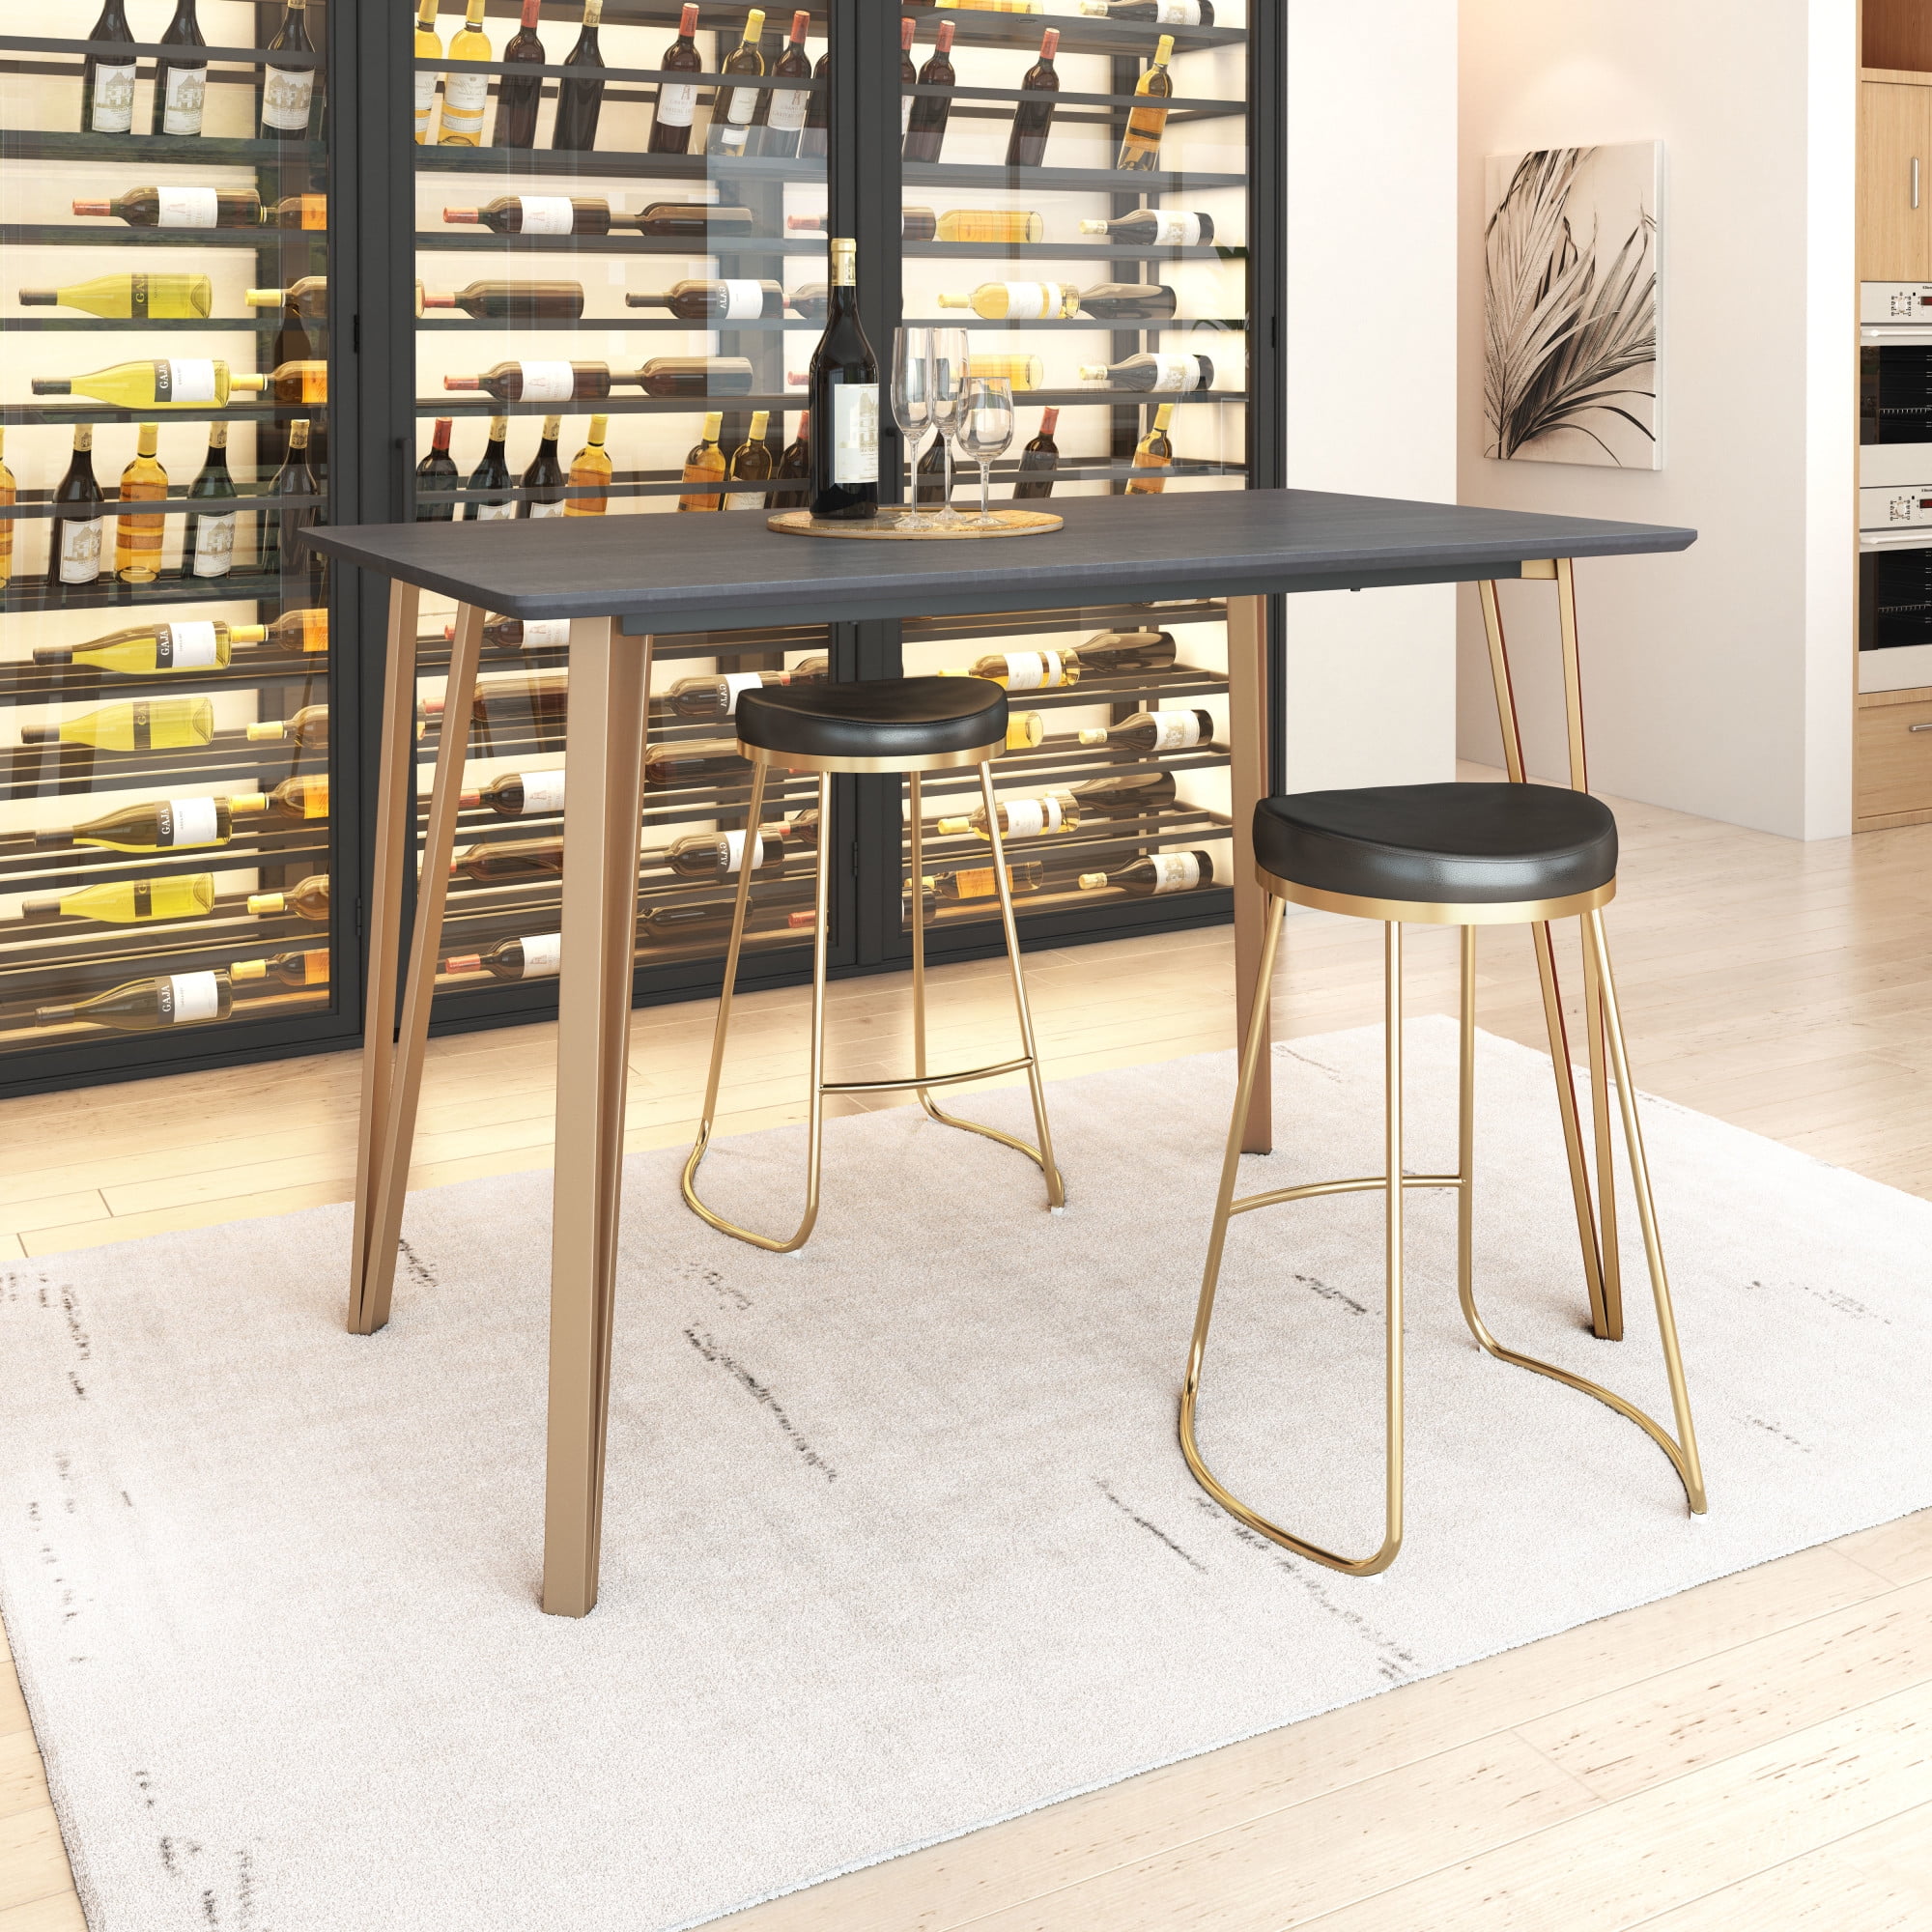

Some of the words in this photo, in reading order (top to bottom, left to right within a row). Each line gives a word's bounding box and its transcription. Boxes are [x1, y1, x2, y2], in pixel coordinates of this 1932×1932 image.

[159, 363, 170, 389] GAJA
[160, 629, 170, 657] GAJA
[160, 808, 171, 835] GAJA
[161, 984, 171, 1012] GAJA
